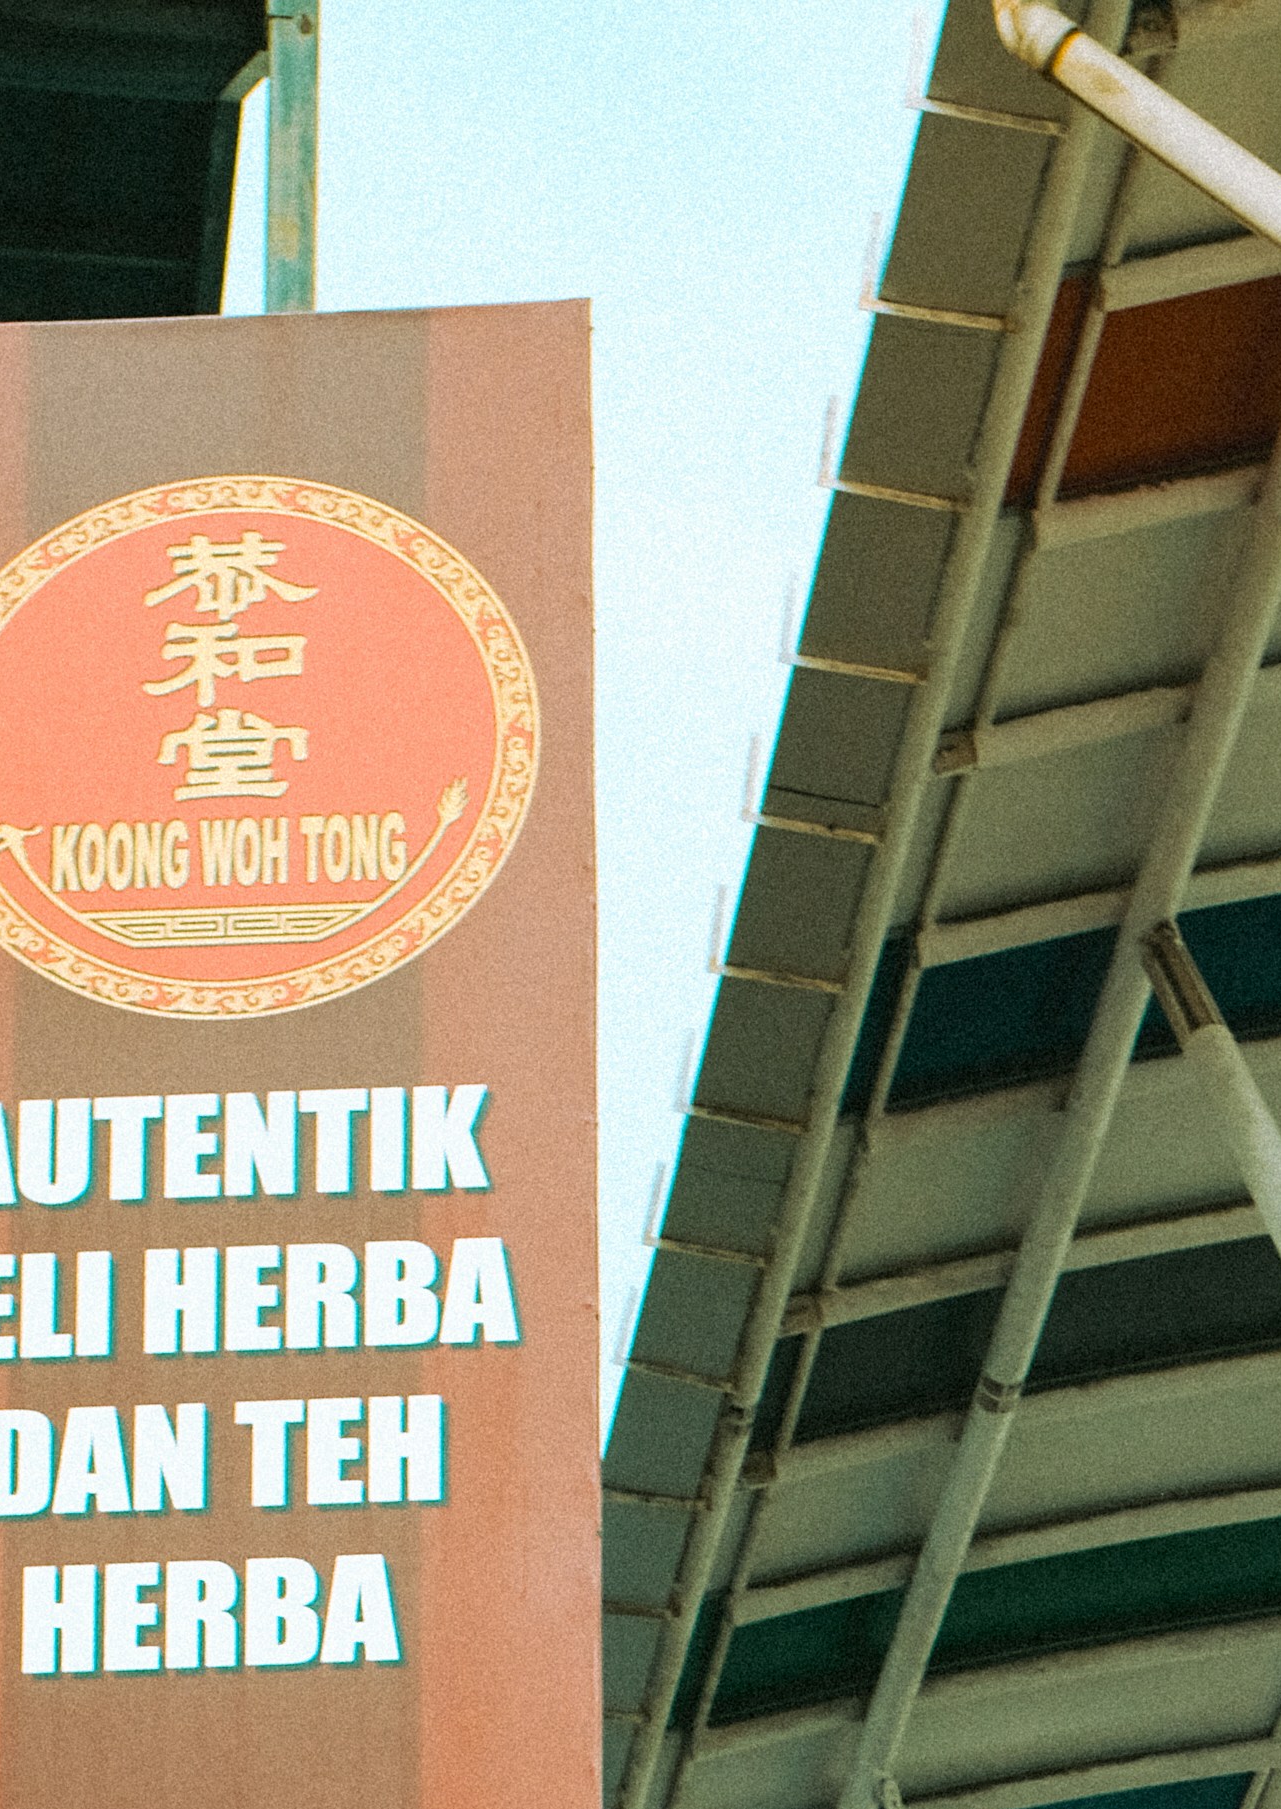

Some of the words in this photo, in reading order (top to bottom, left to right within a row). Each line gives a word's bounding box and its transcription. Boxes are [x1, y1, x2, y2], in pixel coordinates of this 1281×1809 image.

[143, 531, 320, 802] 恭和堂
[51, 819, 191, 893] KOONG
[198, 817, 290, 888] WOH
[299, 811, 408, 883] TONG
[143, 1236, 521, 1355] HERBA
[233, 1393, 444, 1508] TEH
[21, 1552, 402, 1675] HERBA
